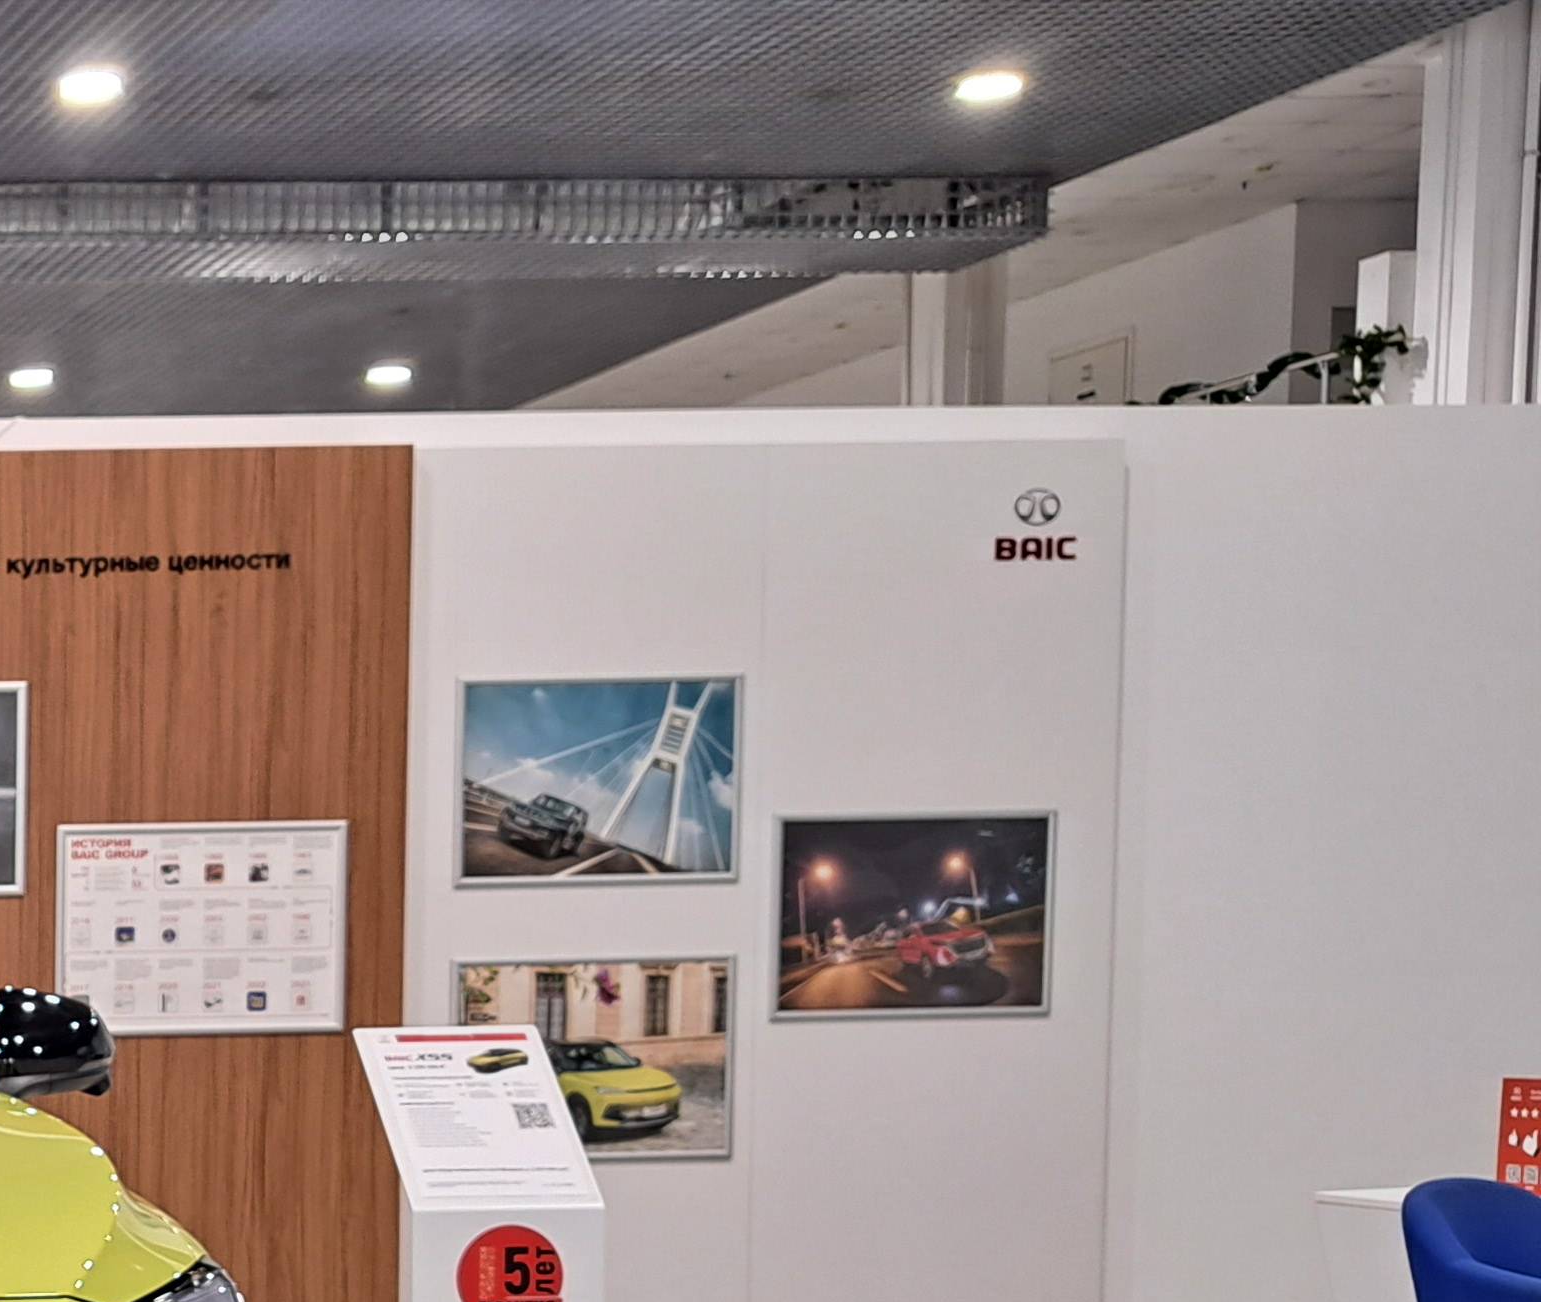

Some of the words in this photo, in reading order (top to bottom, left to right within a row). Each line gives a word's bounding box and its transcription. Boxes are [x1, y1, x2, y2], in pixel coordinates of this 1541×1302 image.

[995, 536, 1078, 561] BAIC
[6, 553, 159, 579] культурные
[169, 551, 291, 574] ценности
[71, 839, 132, 848] ИСТОРИЯ
[504, 1246, 531, 1296] 5
[535, 1245, 558, 1296] лет
